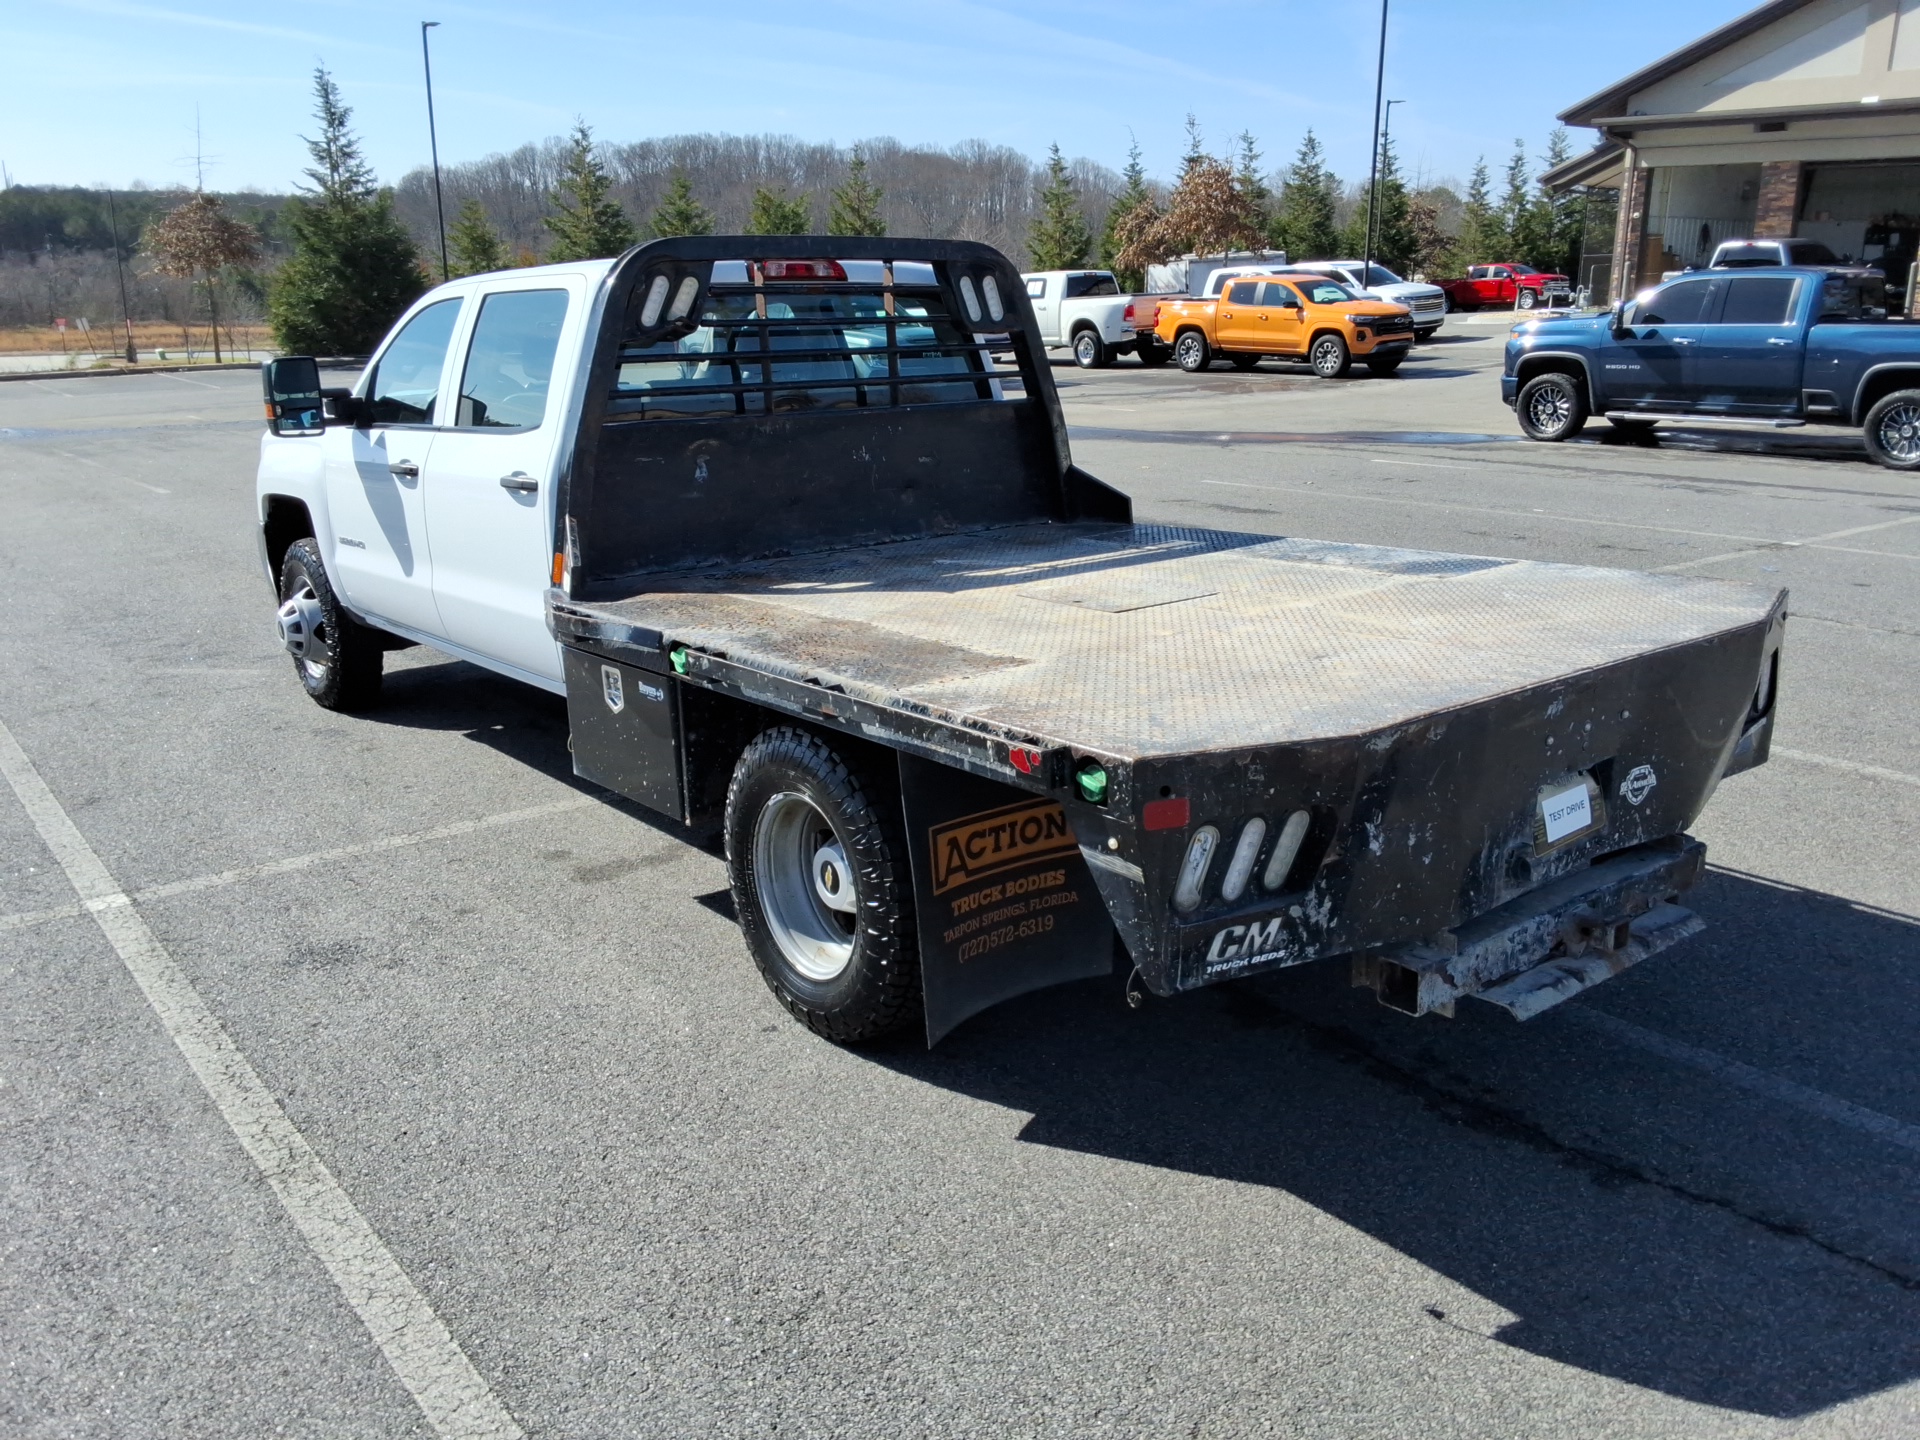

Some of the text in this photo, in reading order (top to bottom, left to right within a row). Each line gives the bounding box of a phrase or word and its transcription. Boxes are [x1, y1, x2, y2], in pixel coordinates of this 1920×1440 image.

[1548, 800, 1586, 823] TEST DRIVE
[937, 810, 1068, 888] ACTION
[943, 919, 980, 943] TARPON
[1029, 891, 1079, 911] FLORIDA
[951, 869, 1066, 917] TRUCK BODIES
[958, 914, 1054, 963] (727)572-6319
[1206, 917, 1283, 962] CM
[1250, 949, 1287, 964] BEDS
